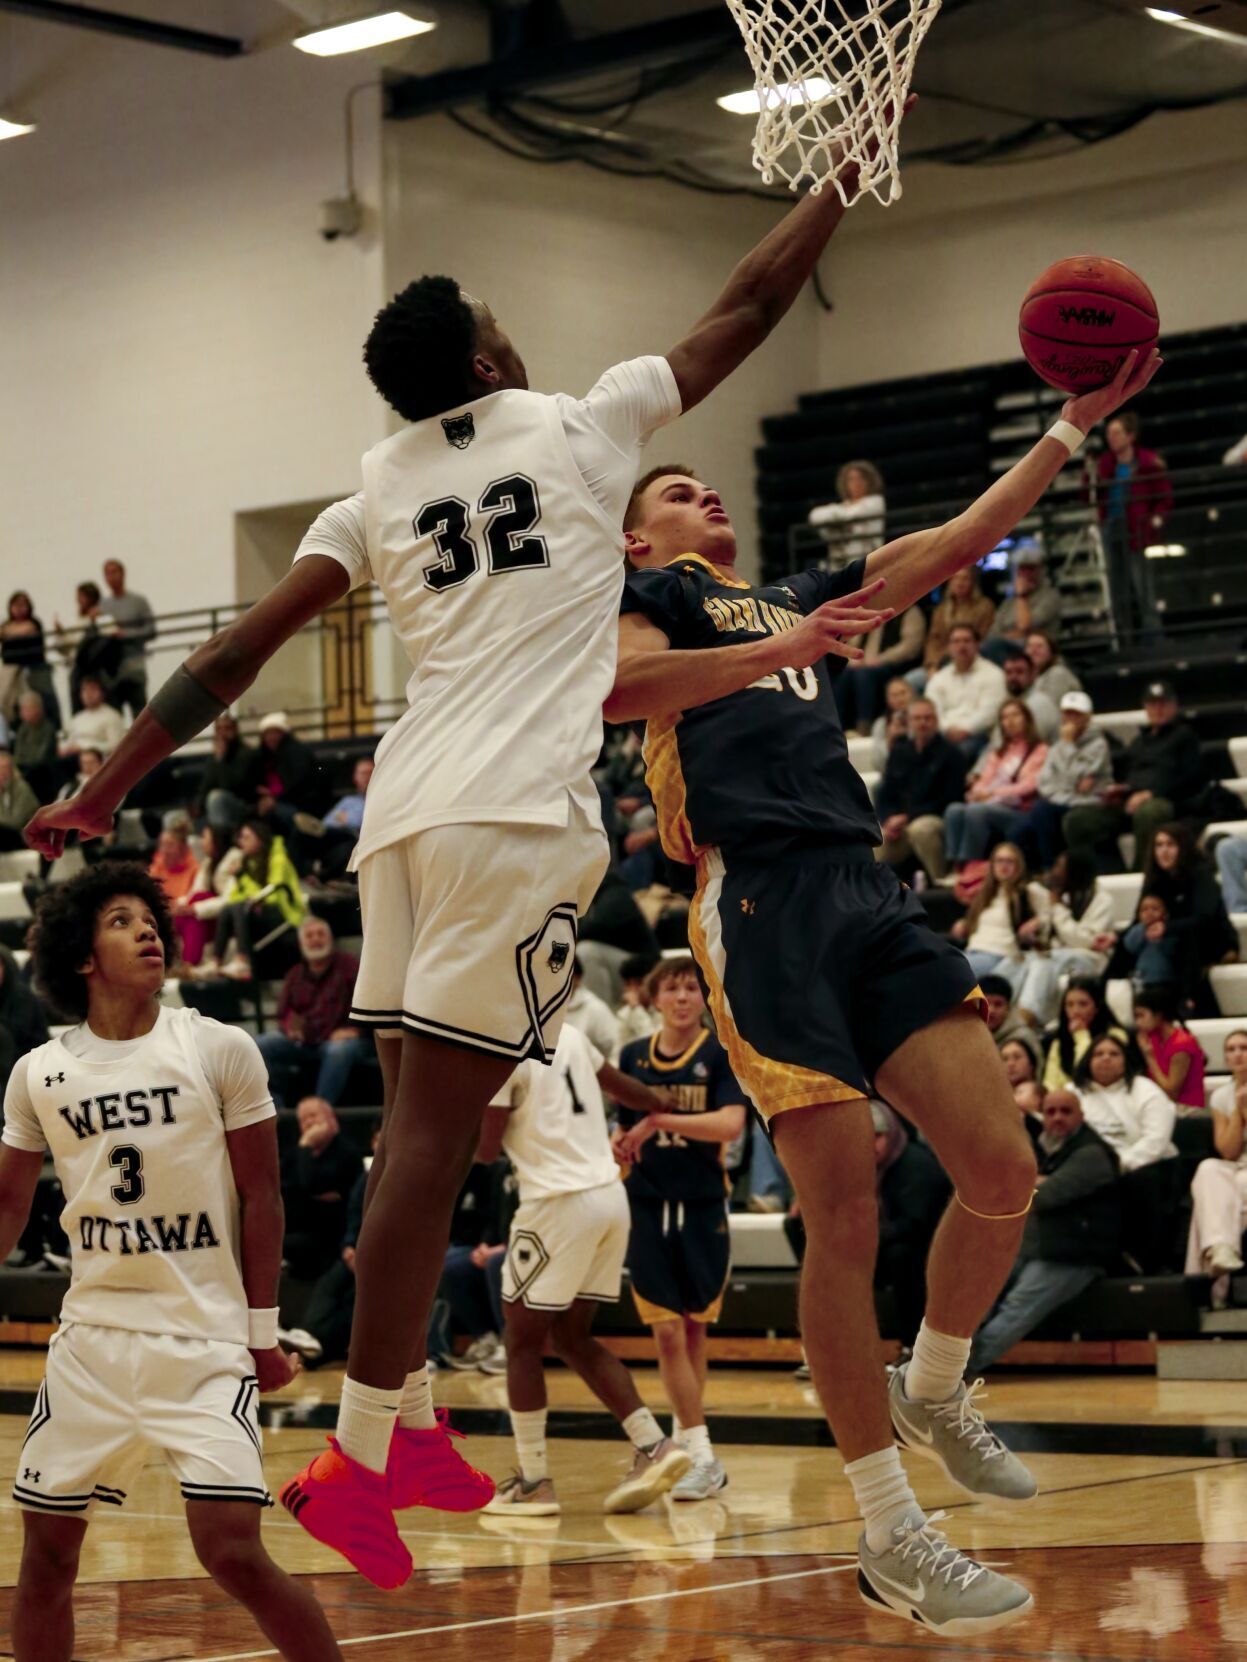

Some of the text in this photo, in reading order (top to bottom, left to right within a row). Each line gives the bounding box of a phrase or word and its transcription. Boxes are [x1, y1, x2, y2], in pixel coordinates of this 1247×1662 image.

[412, 472, 551, 594] 32
[58, 1085, 180, 1140] WEST
[108, 1144, 145, 1206] 3
[80, 1211, 221, 1256] OTTAWA
